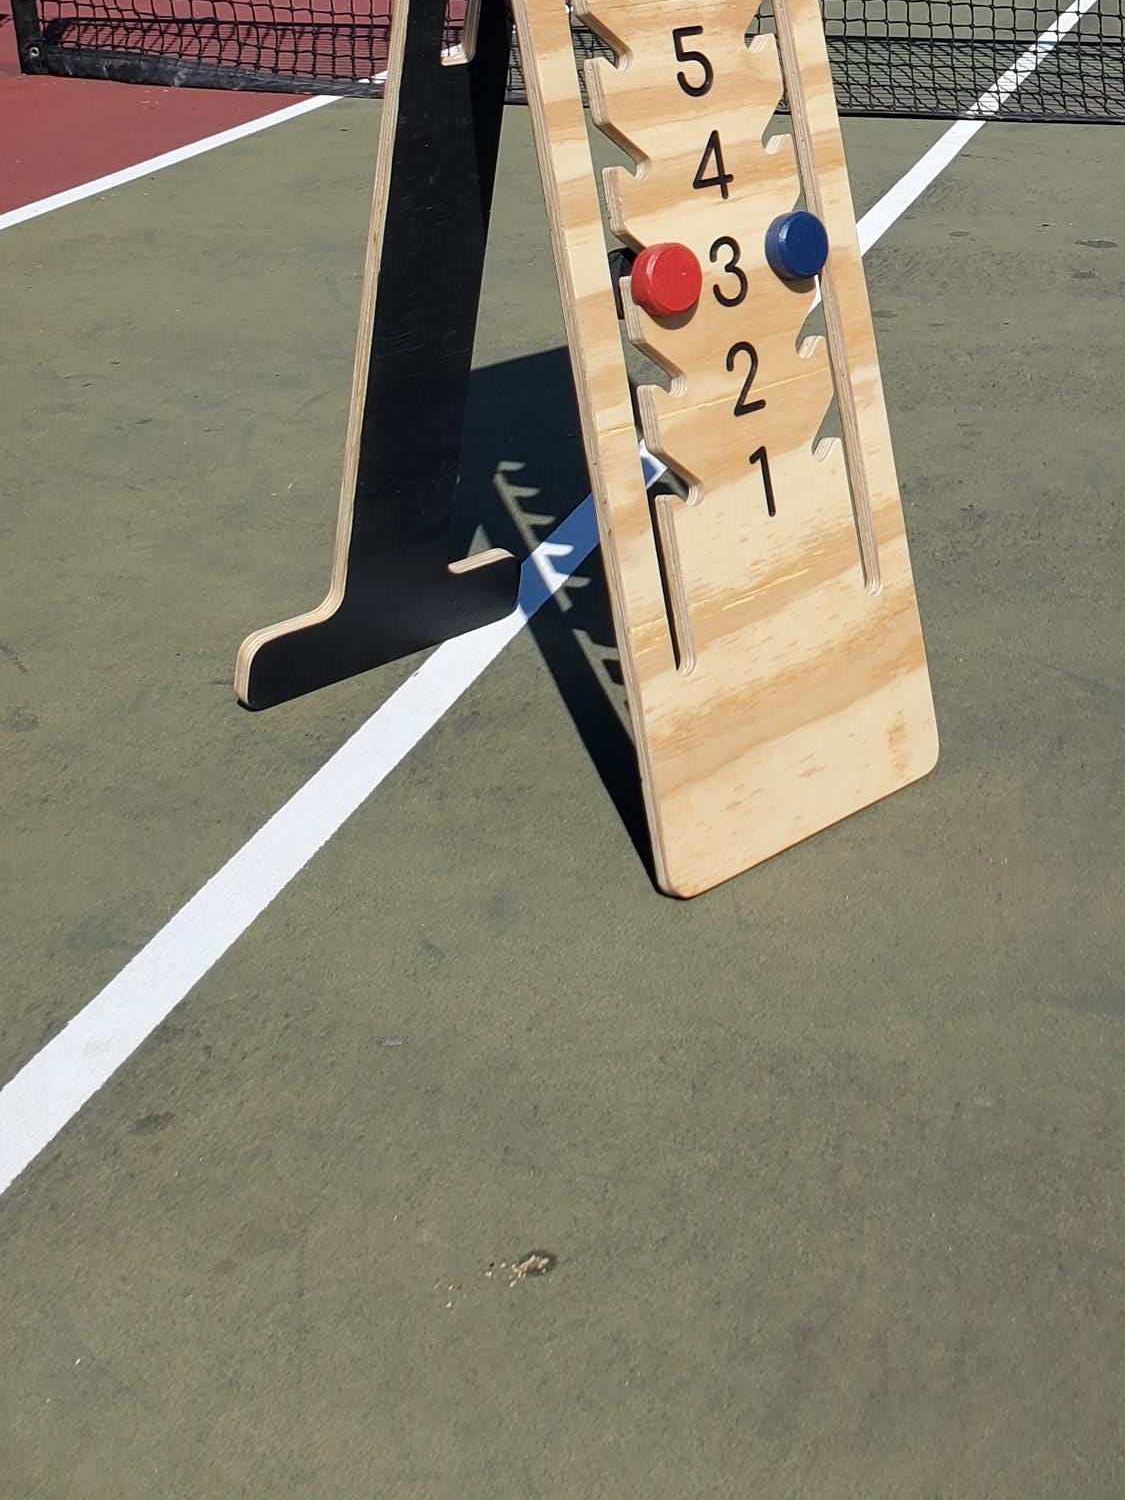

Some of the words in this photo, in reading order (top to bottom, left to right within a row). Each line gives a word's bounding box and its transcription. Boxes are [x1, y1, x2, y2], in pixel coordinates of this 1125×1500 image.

[672, 25, 714, 98] 5
[692, 129, 734, 200] 4
[709, 235, 749, 308] 3
[725, 341, 767, 417] 2
[748, 445, 777, 518] 1
